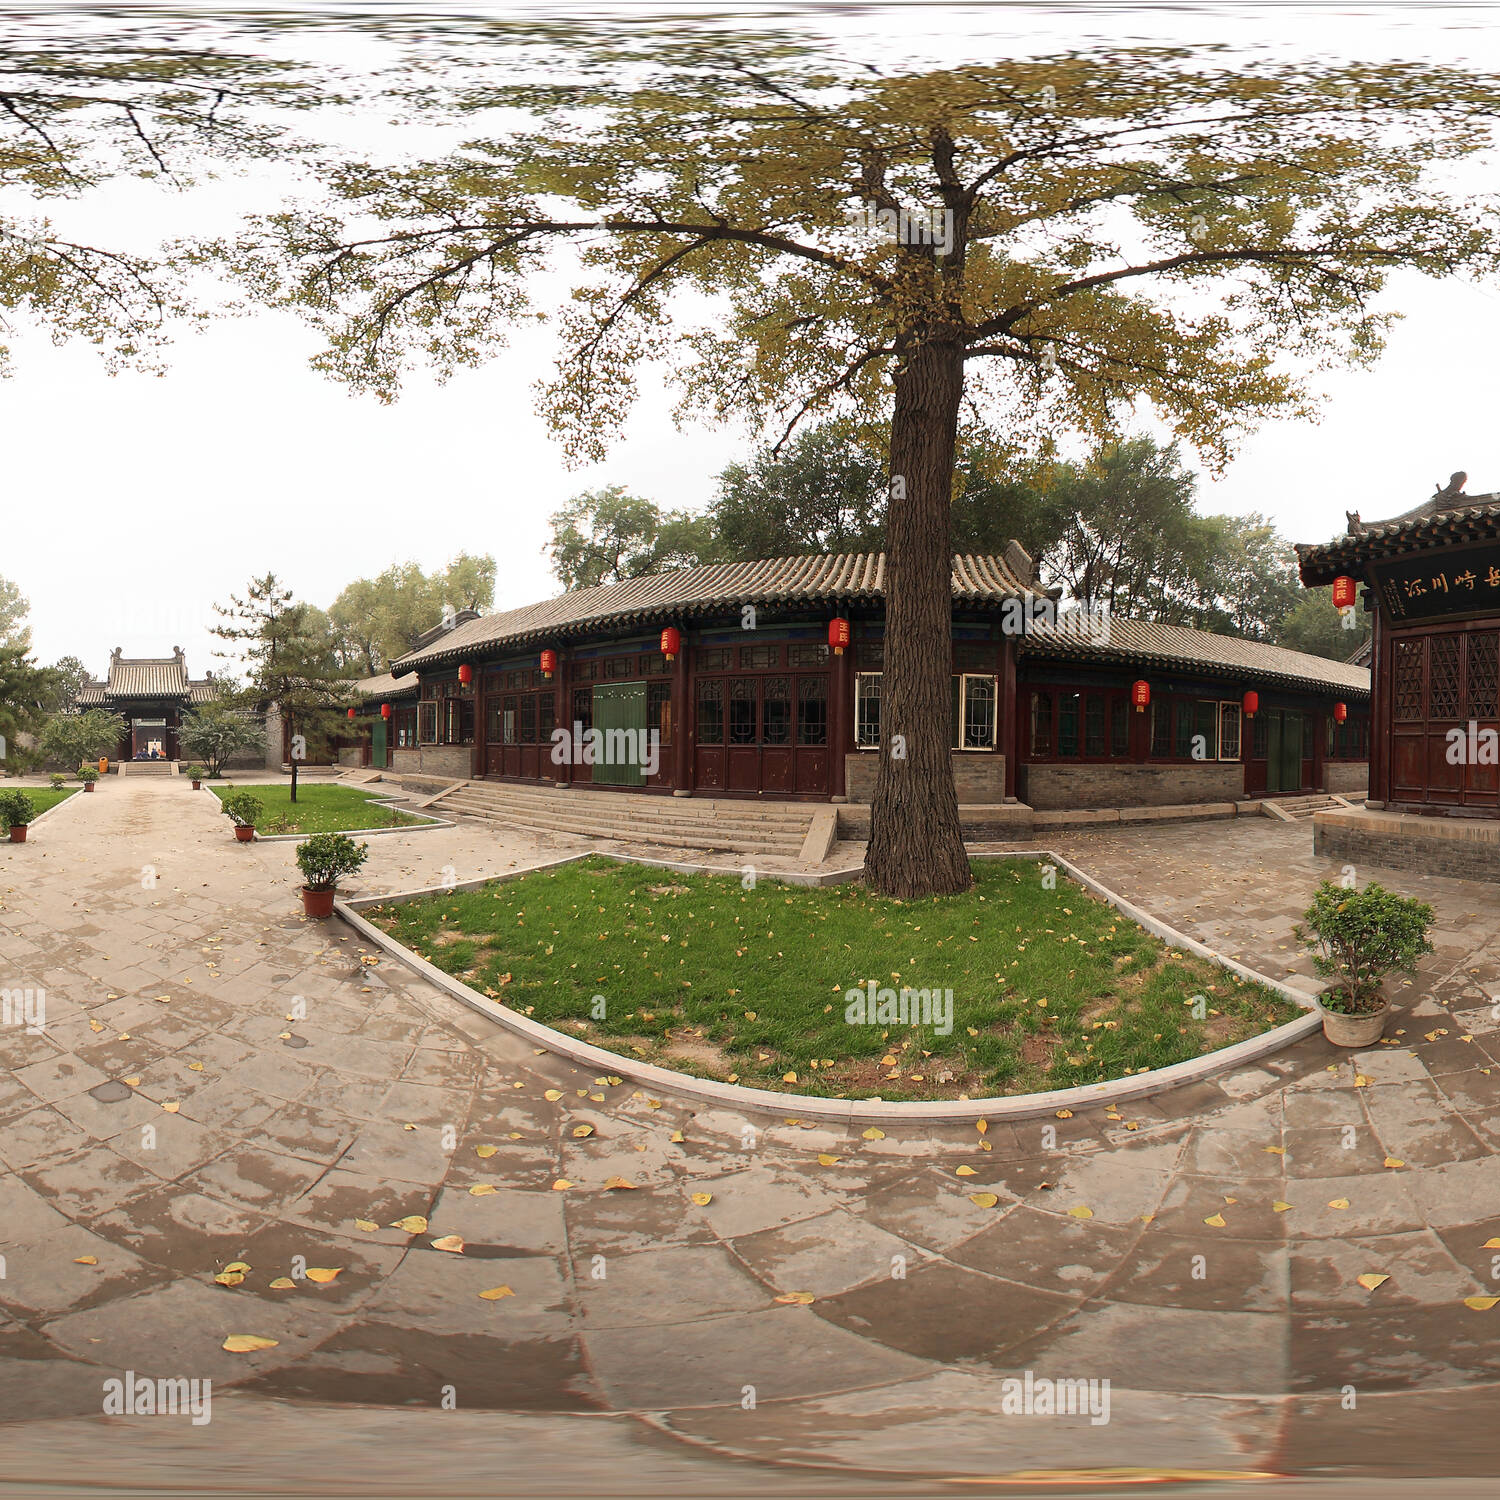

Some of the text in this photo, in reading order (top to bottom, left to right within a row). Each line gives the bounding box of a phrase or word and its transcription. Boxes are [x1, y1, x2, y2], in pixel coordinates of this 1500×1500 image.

[1337, 580, 1347, 599] 王氏
[840, 623, 848, 642] 王氏
[1138, 686, 1146, 701] 王氏
